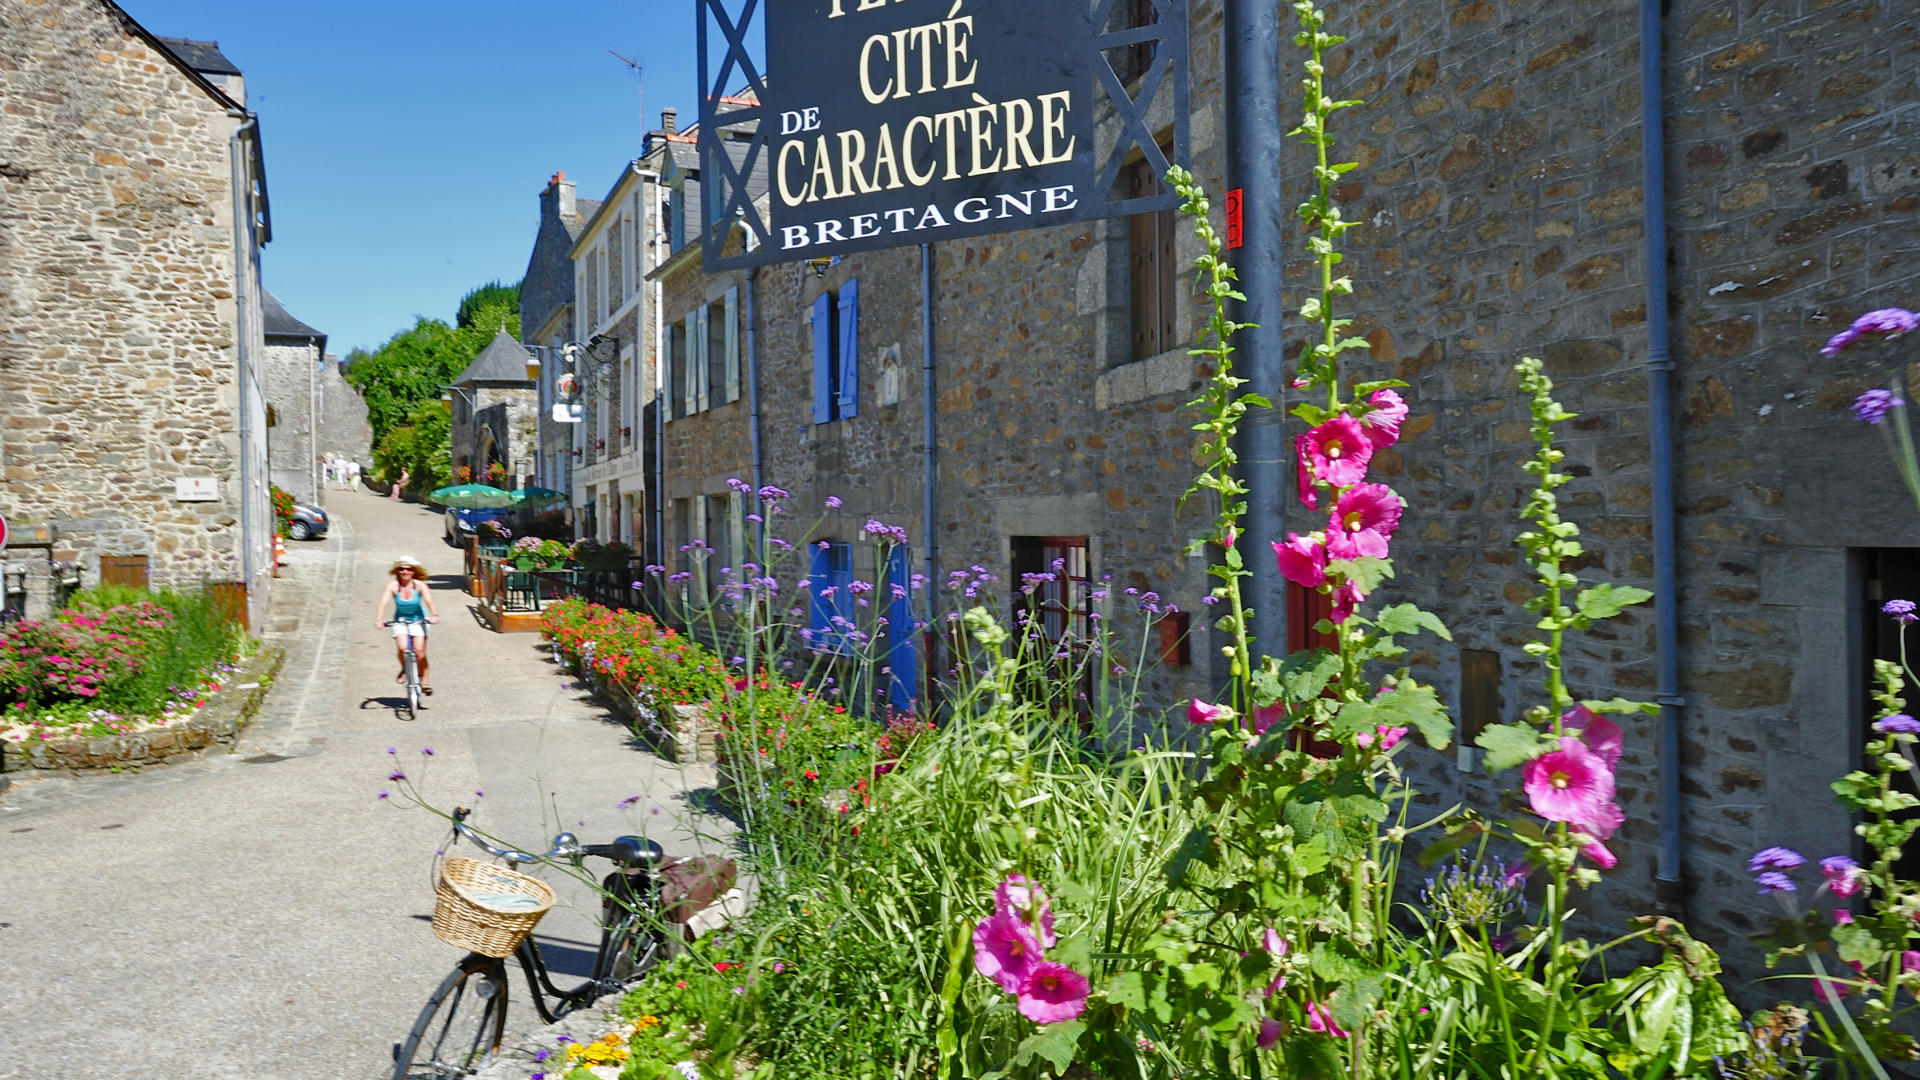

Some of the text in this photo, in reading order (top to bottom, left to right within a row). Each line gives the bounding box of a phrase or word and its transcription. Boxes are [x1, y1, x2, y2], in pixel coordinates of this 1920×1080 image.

[859, 0, 978, 104] CITÉ
[777, 90, 1076, 207] CARACTÈRE
[780, 106, 822, 135] DE
[780, 184, 1079, 250] BRETAGNE
